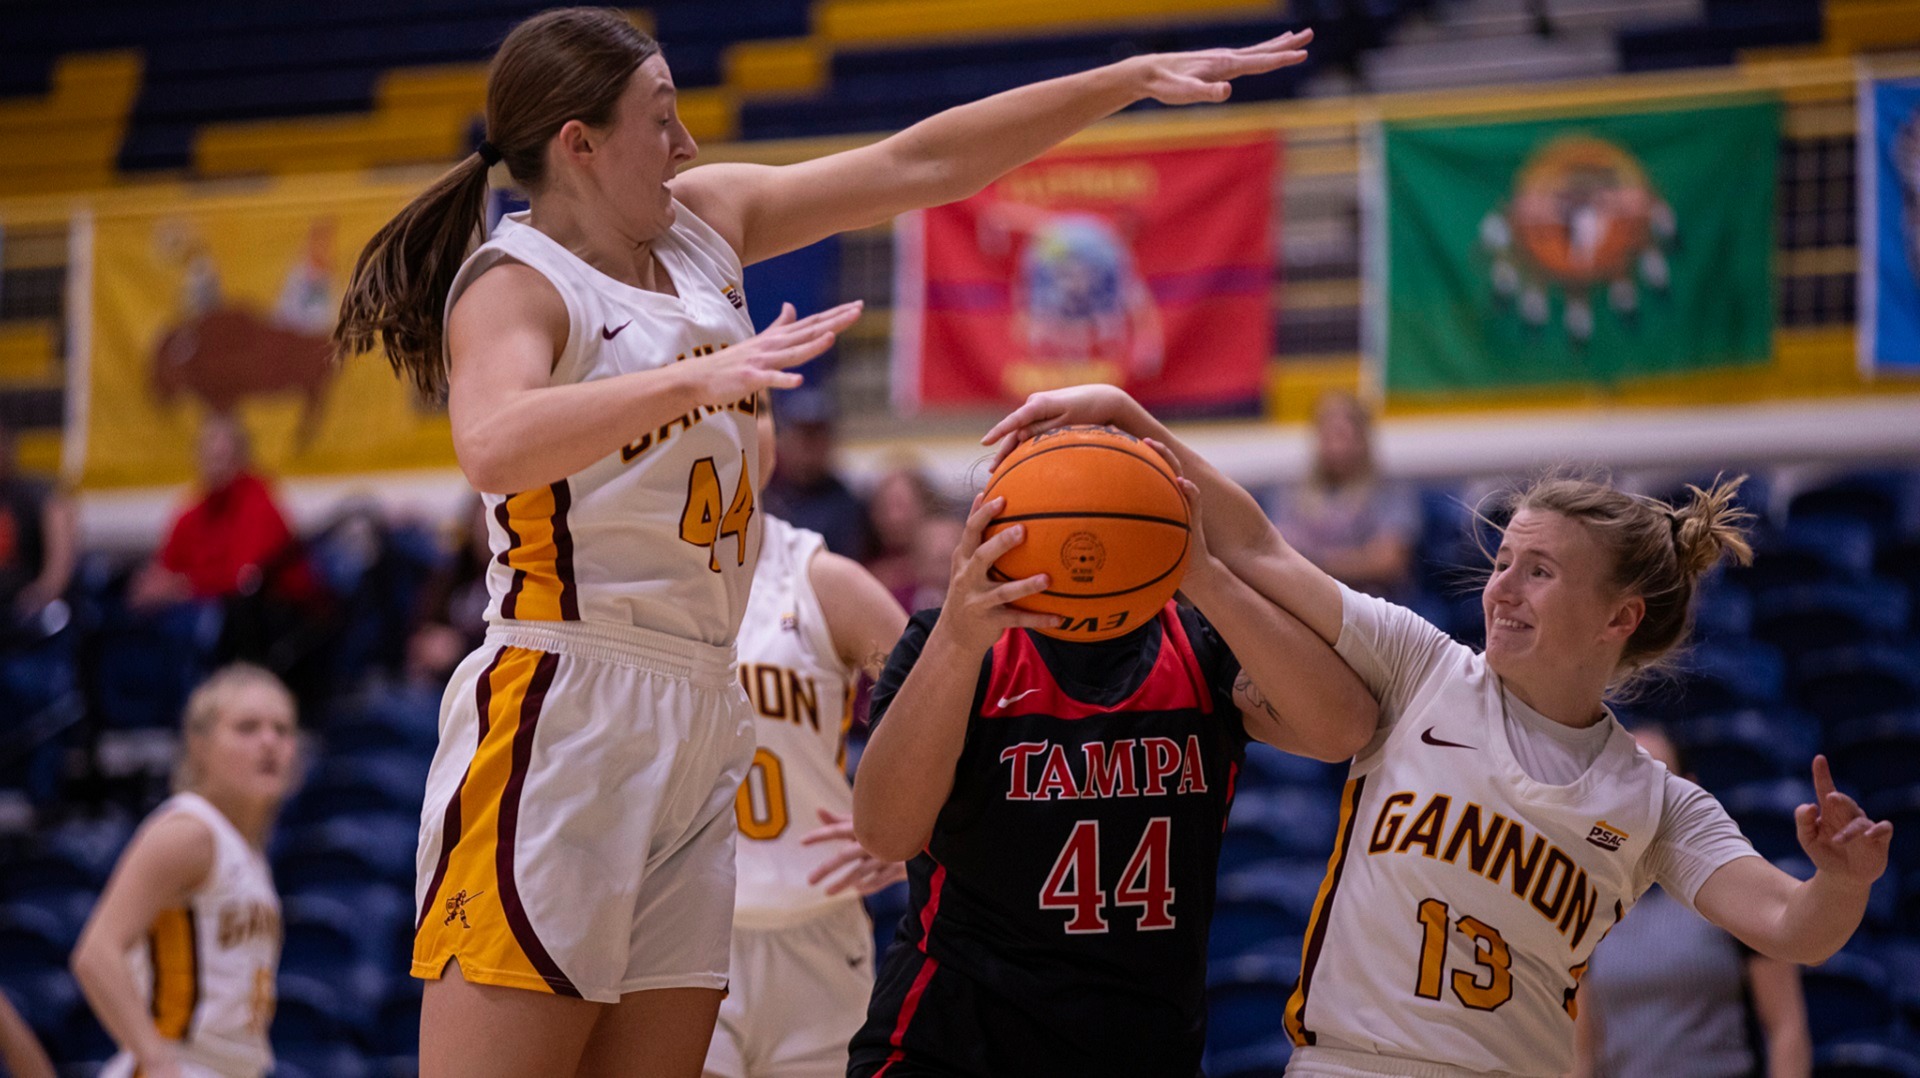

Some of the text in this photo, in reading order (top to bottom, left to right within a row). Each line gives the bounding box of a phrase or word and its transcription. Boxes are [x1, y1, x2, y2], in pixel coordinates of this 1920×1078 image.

[679, 448, 754, 573] 44
[735, 746, 789, 841] 0
[1001, 735, 1208, 800] TAMPA
[1039, 816, 1176, 934] 44
[1367, 791, 1598, 952] GANNON
[1588, 825, 1628, 847] PSAC
[1414, 897, 1513, 1012] 13
